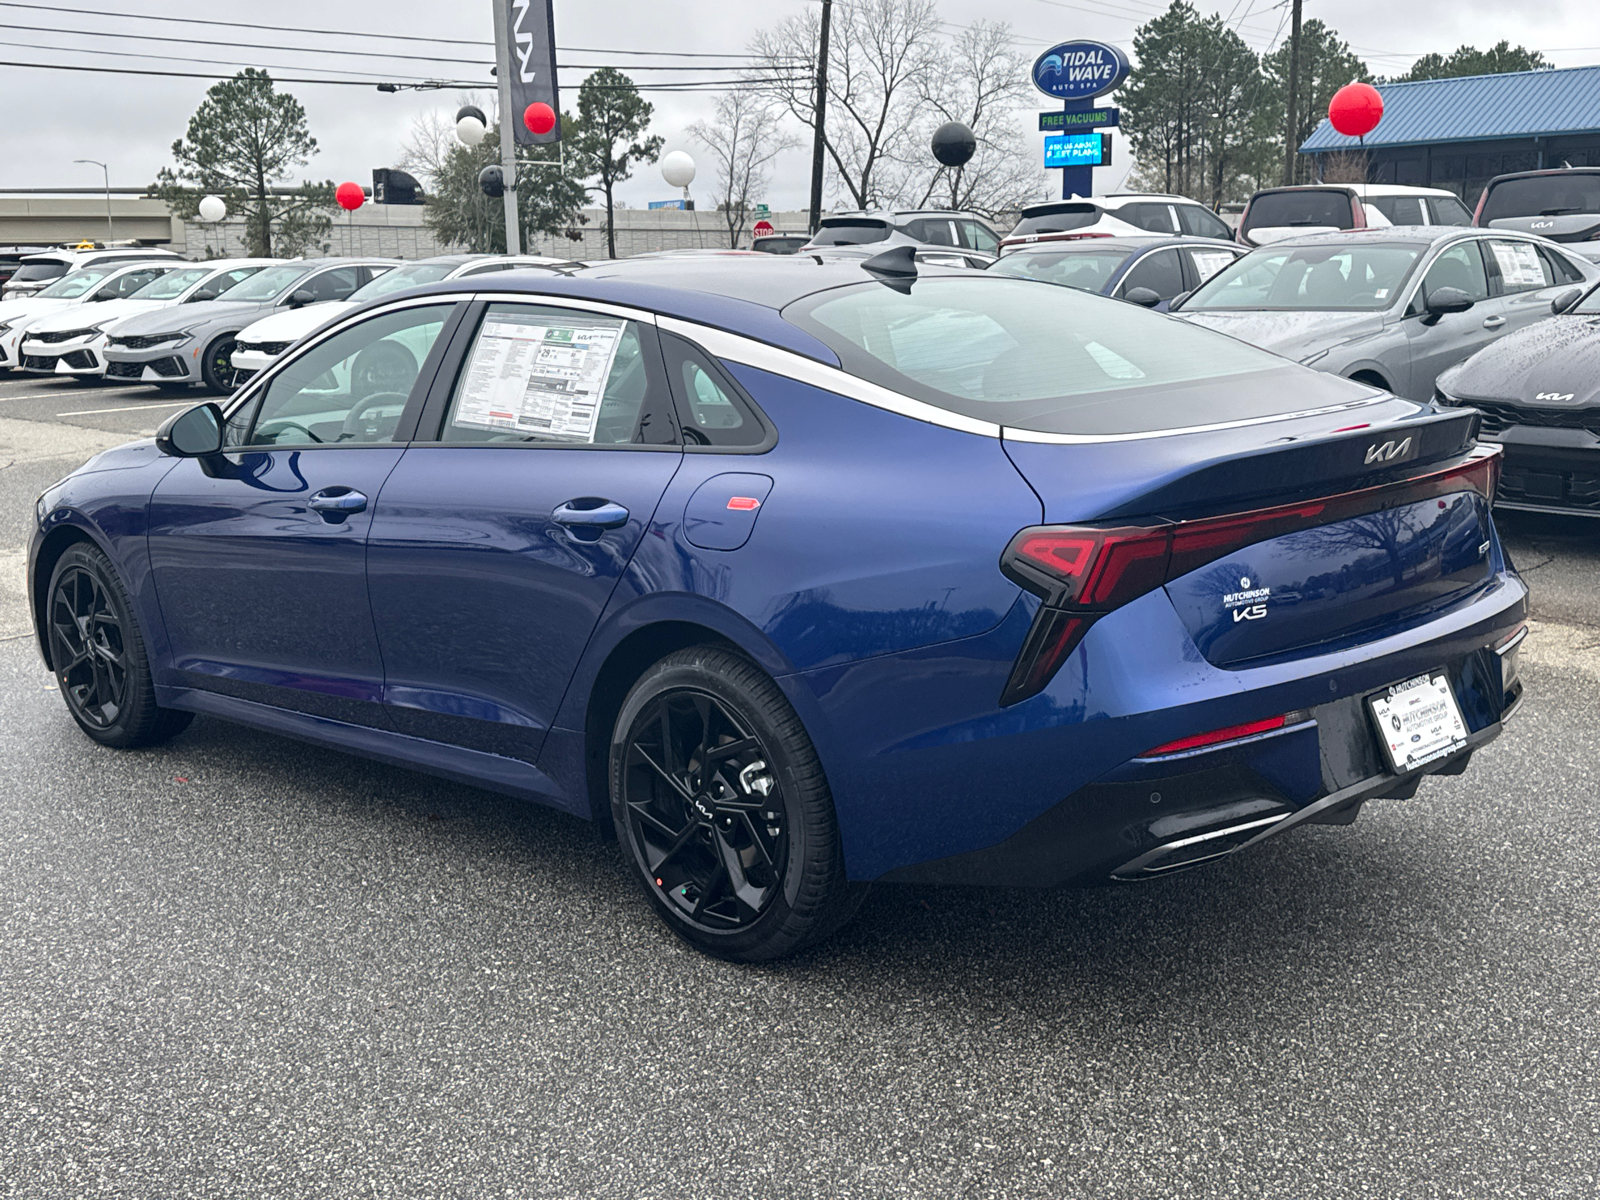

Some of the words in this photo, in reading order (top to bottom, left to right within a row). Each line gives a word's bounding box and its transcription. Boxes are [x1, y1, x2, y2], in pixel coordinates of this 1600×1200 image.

[1062, 50, 1104, 67] TIDAL
[1068, 64, 1113, 82] WAVE
[1042, 115, 1064, 126] FREE
[1066, 112, 1107, 125] VACUUMS
[1048, 143, 1063, 151] ASK
[1063, 142, 1073, 150] US
[1074, 141, 1097, 149] ABOUT
[1072, 148, 1099, 157] PLANS
[1530, 221, 1554, 229] KIA
[754, 228, 774, 238] STOP
[1535, 392, 1575, 402] KIA
[1363, 436, 1413, 465] KIA
[1223, 587, 1270, 603] HUTCHINSON
[1224, 599, 1254, 608] AUTOMOTIVE
[1254, 595, 1270, 604] GROUP
[1232, 603, 1268, 623] K5
[1395, 674, 1430, 694] HUTCHINSON
[1378, 707, 1391, 716] KIA
[1402, 700, 1448, 726] HUTCHINSON
[1406, 716, 1434, 733] AUTOMOTIVE
[1433, 711, 1448, 722] GROUP
[1430, 725, 1442, 734] KIA
[695, 800, 714, 820] KIA
